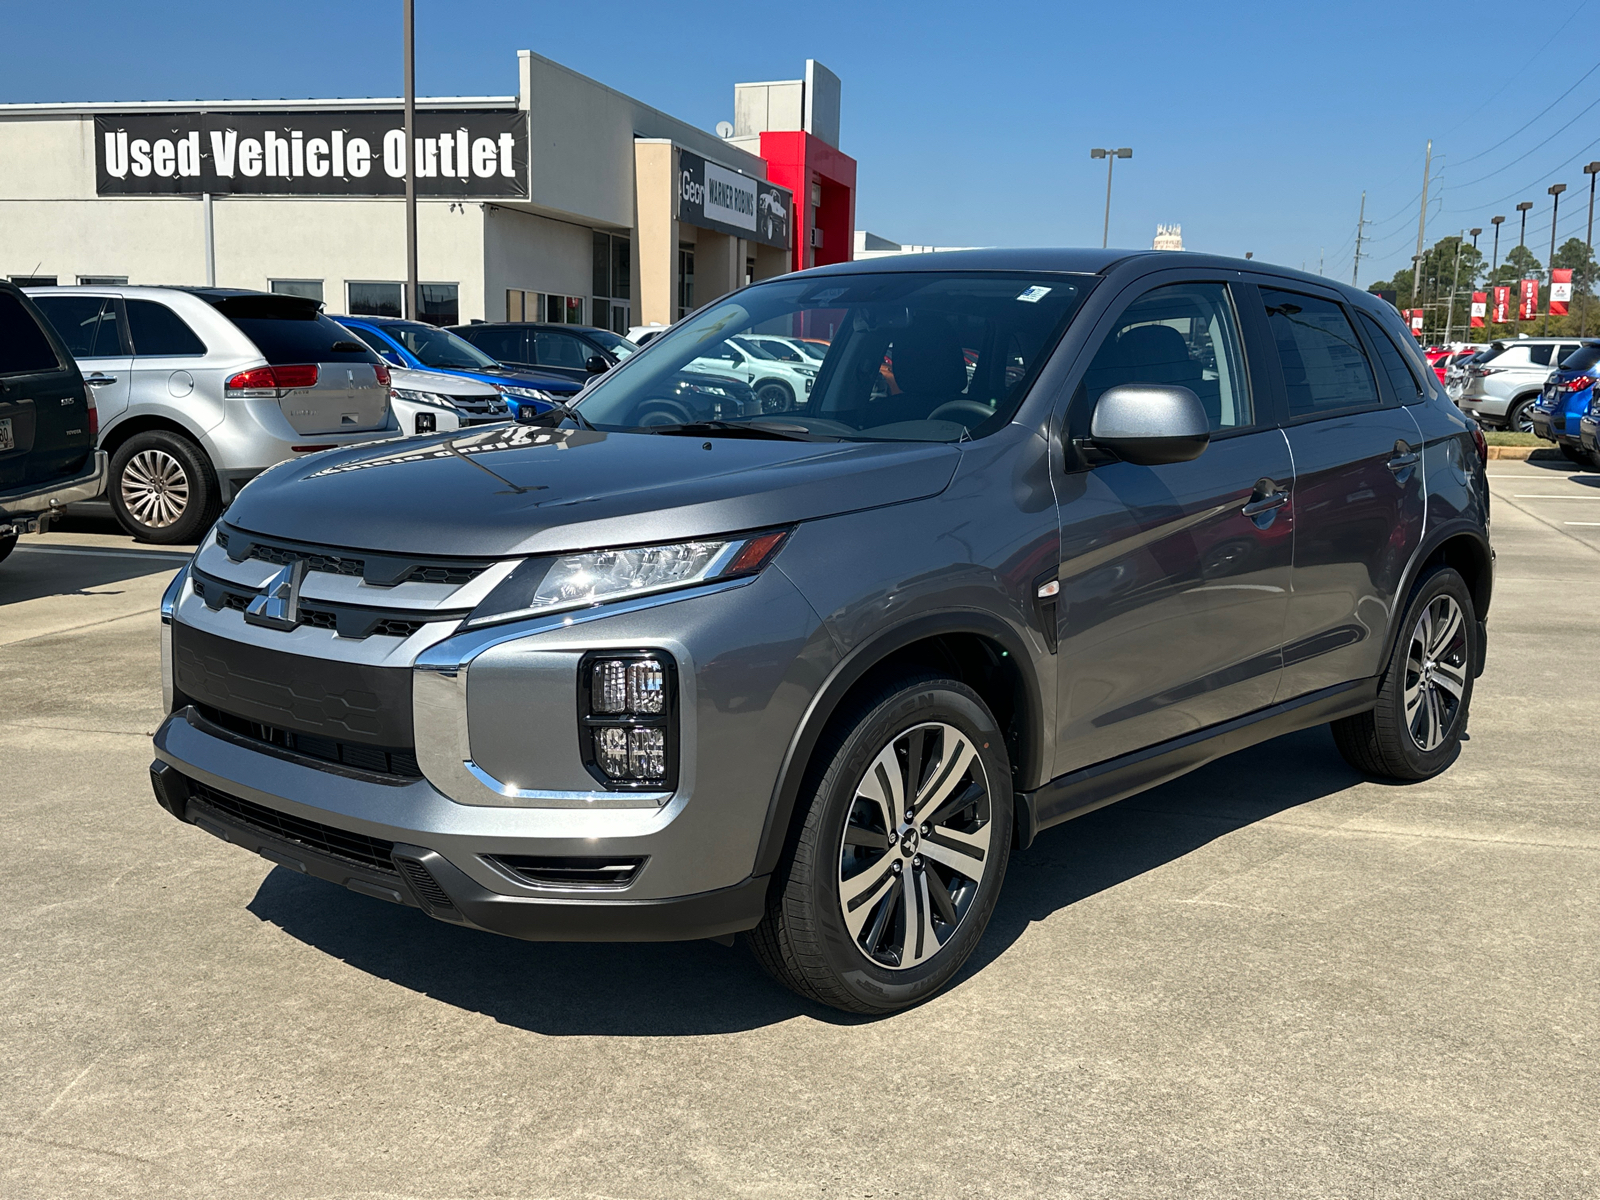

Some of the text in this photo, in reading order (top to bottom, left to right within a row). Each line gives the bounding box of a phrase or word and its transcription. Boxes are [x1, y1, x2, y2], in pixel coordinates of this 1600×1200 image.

[104, 129, 516, 179] Used Vehicle Outlet
[708, 178, 754, 217] WARNER ROBINS
[849, 692, 935, 774] NEXEN
